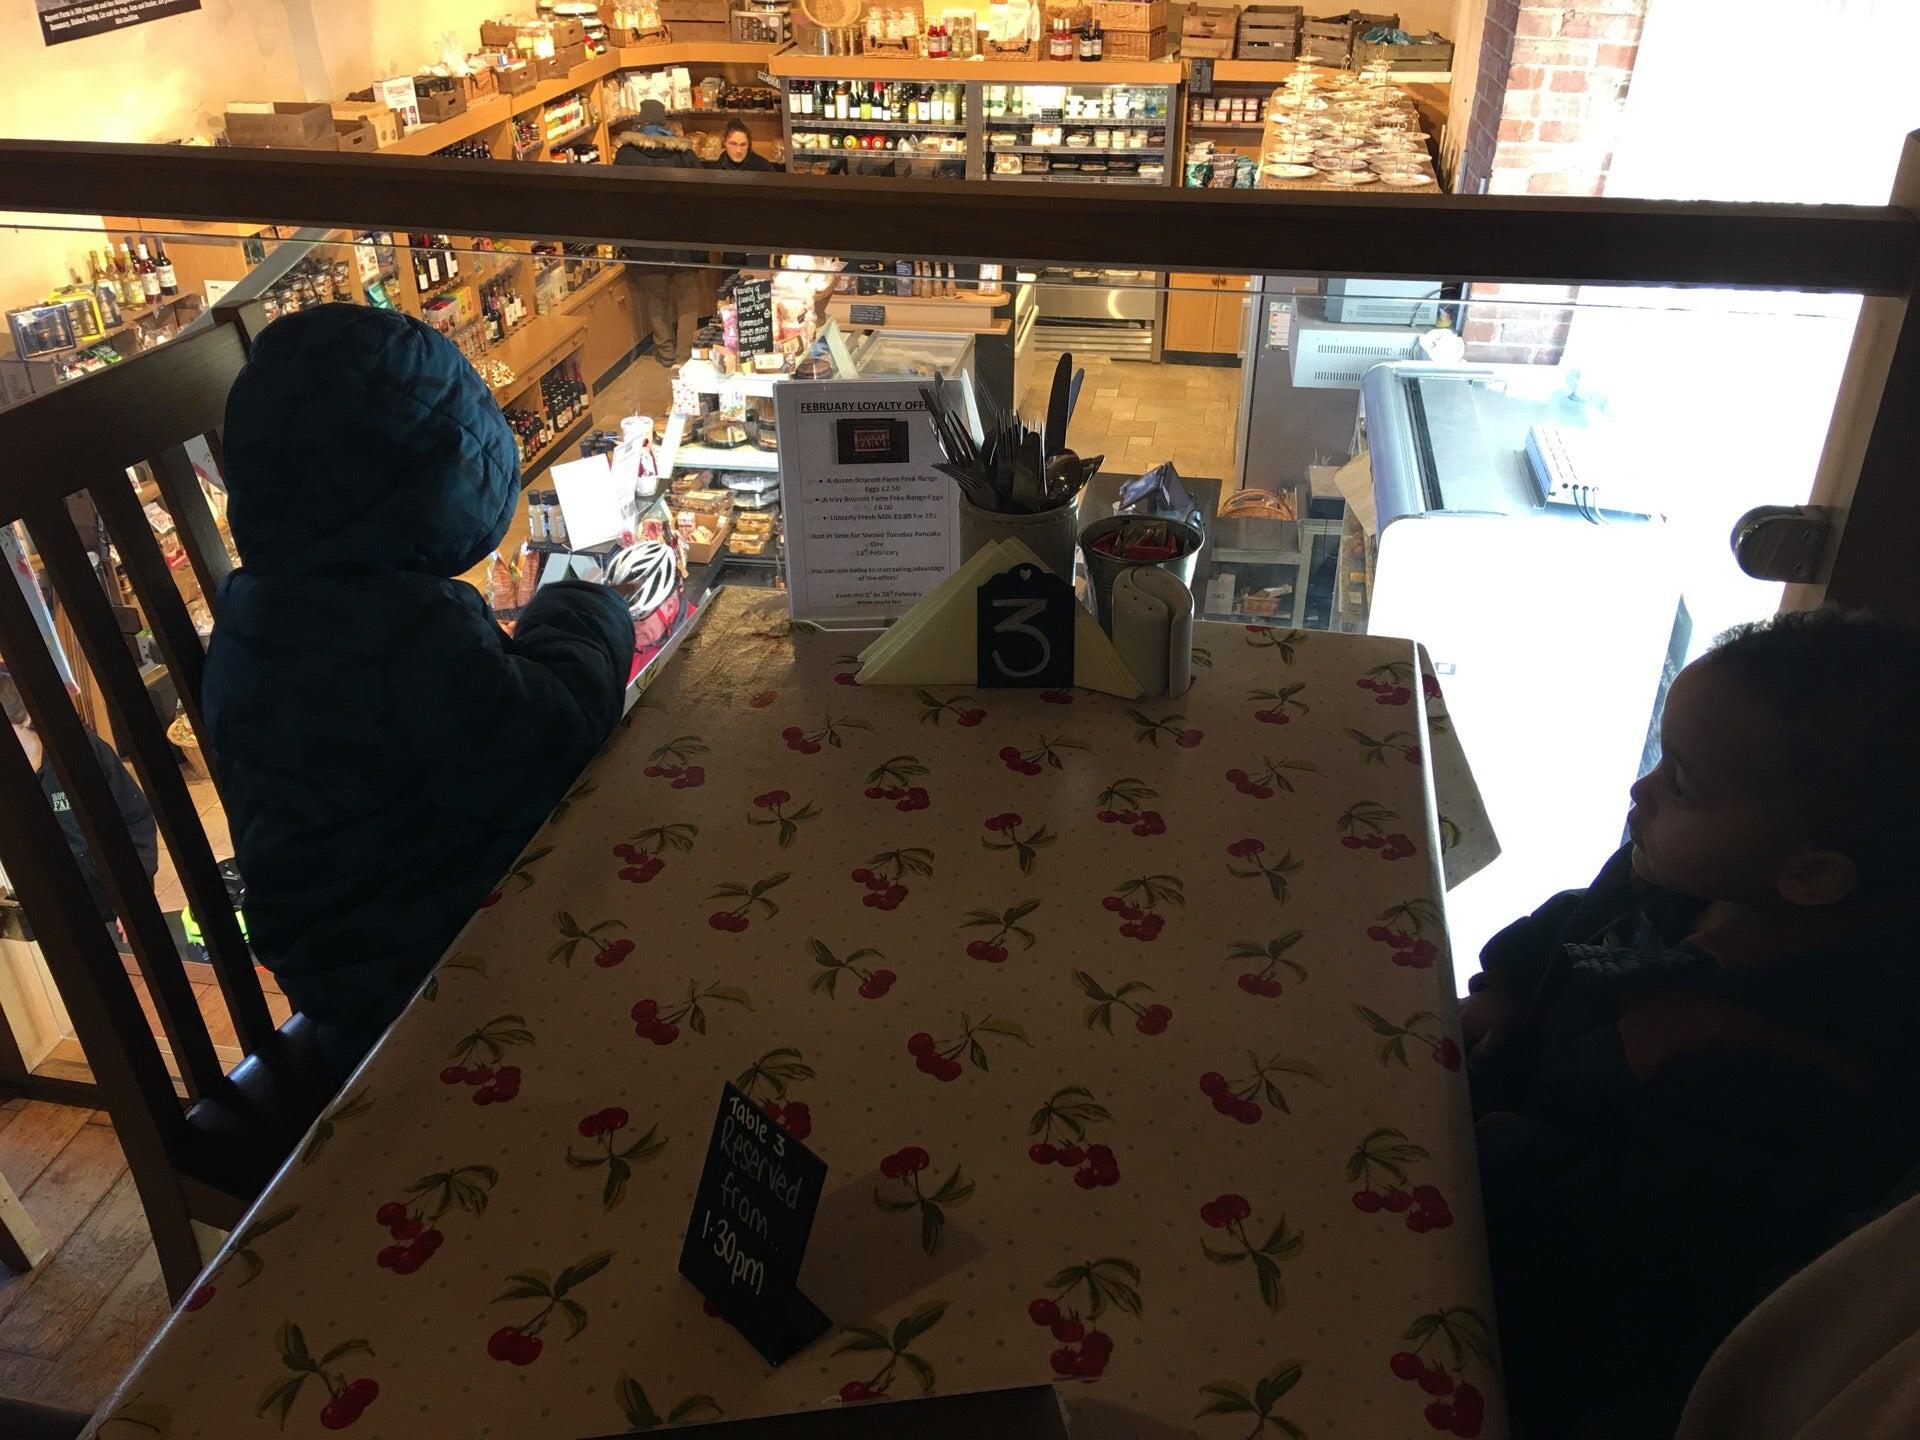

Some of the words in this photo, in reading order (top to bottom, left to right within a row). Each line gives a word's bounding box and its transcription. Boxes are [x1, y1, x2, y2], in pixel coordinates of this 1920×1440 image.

[800, 402, 855, 412] FEBRUARY
[857, 401, 902, 411] LOYALTY
[918, 475, 938, 483] Range
[869, 549, 899, 557] February
[992, 598, 1051, 678] 3
[729, 1096, 767, 1143] Table
[773, 1133, 786, 1157] 3
[720, 1115, 803, 1210] Reserved
